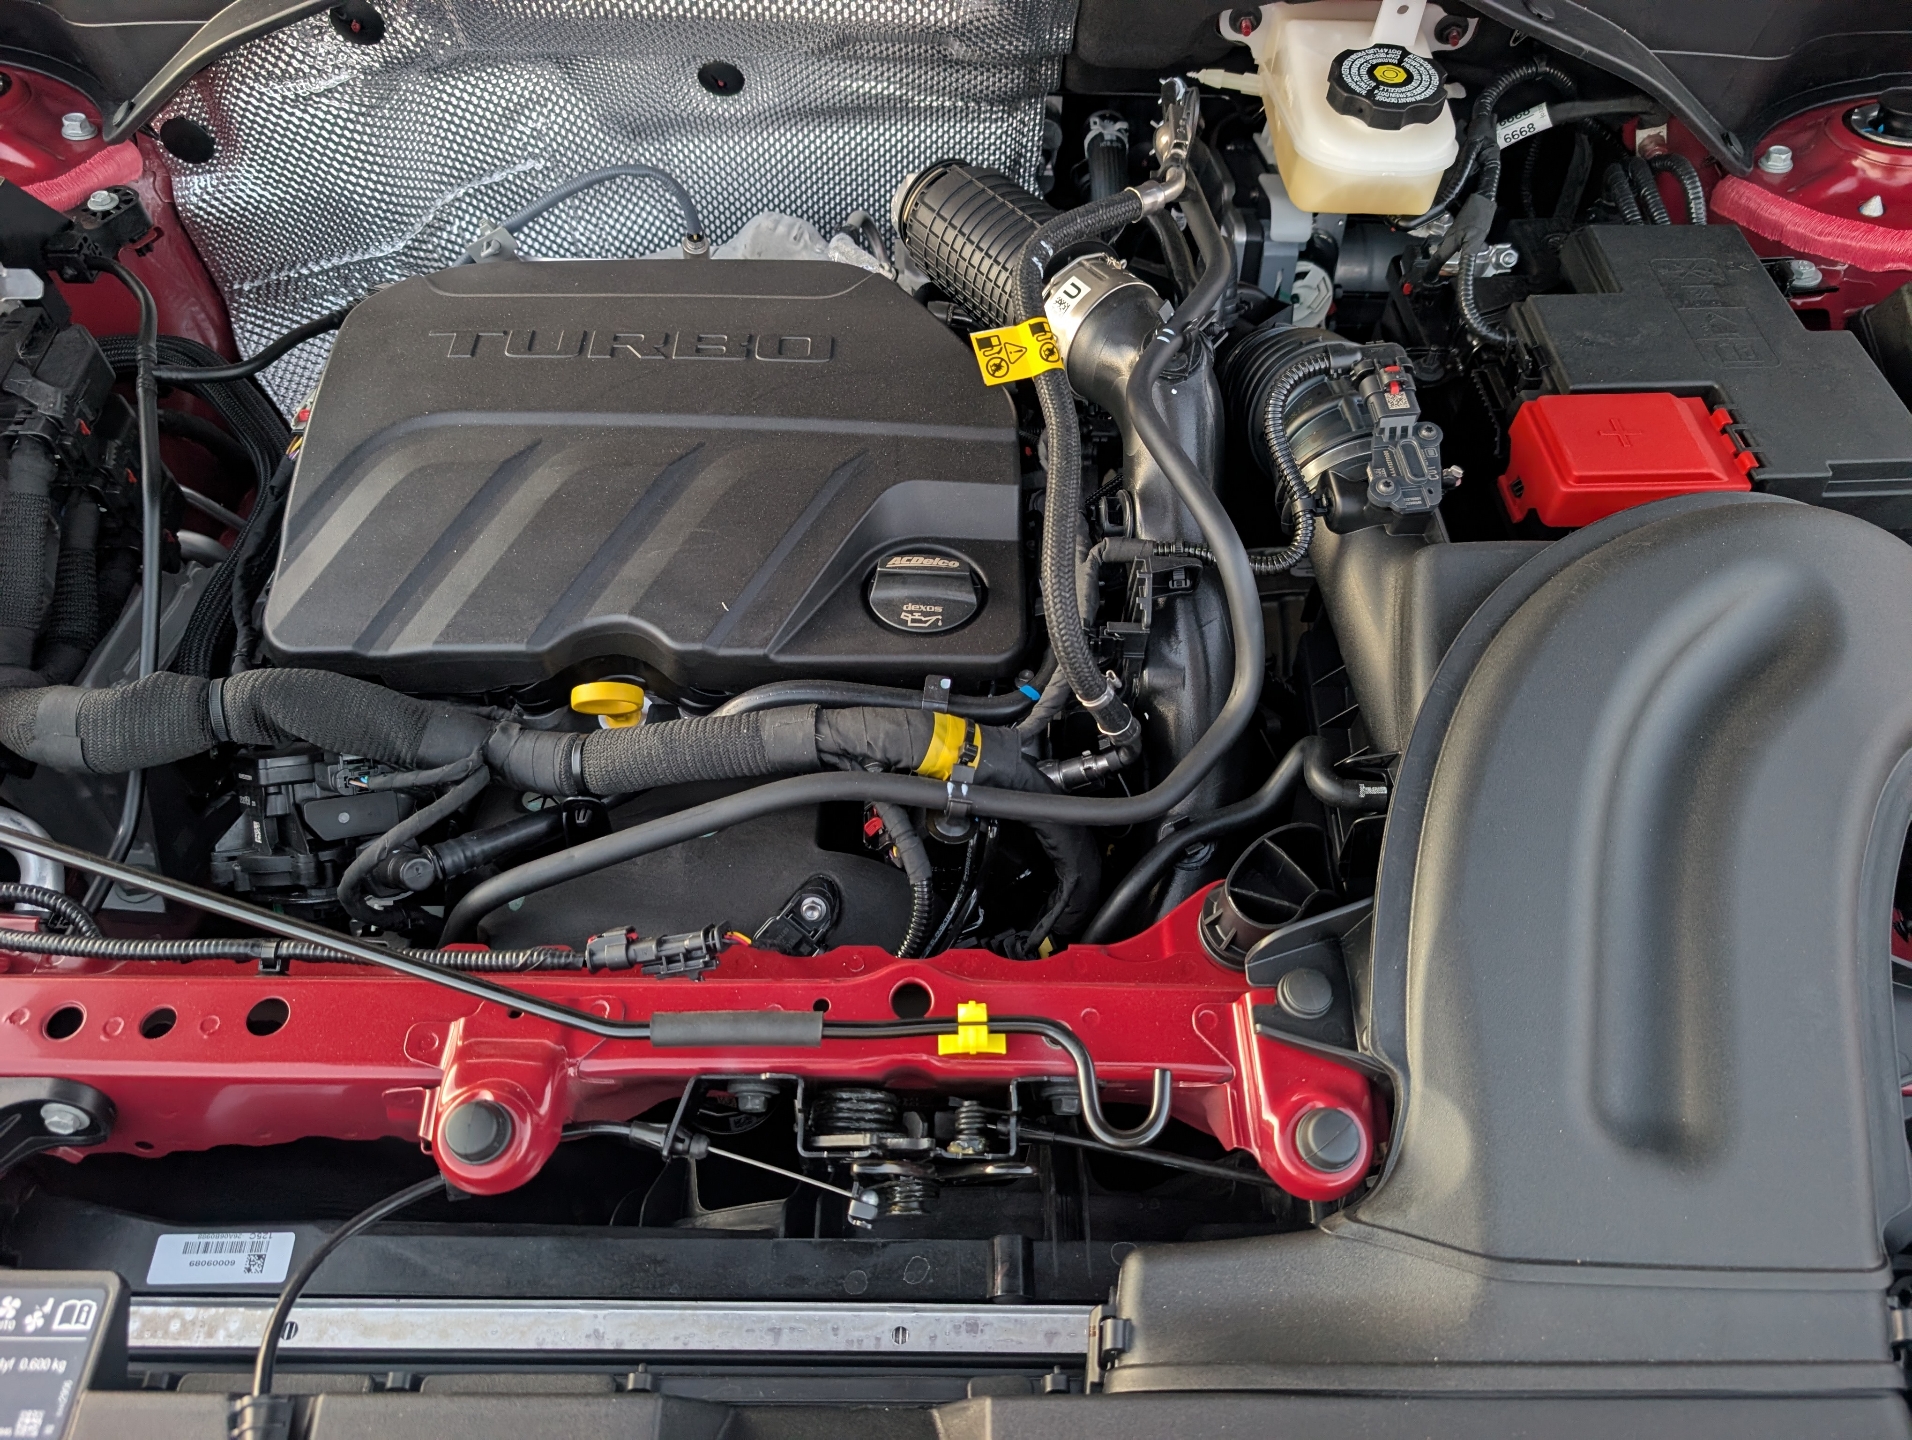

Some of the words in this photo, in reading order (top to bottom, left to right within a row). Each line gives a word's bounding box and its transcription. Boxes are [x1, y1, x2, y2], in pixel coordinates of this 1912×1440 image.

[1361, 52, 1387, 60] BEFORE
[1355, 80, 1373, 91] ONLY
[1396, 95, 1417, 103] AVANT
[1503, 122, 1536, 143] 6668
[1062, 281, 1082, 299] U
[428, 329, 835, 363] TURBO
[885, 556, 960, 568] ACDelco
[902, 603, 944, 613] dexos
[188, 1259, 236, 1267] 60009089
[19, 1357, 52, 1372] 0.600
[52, 1357, 68, 1375] kg
